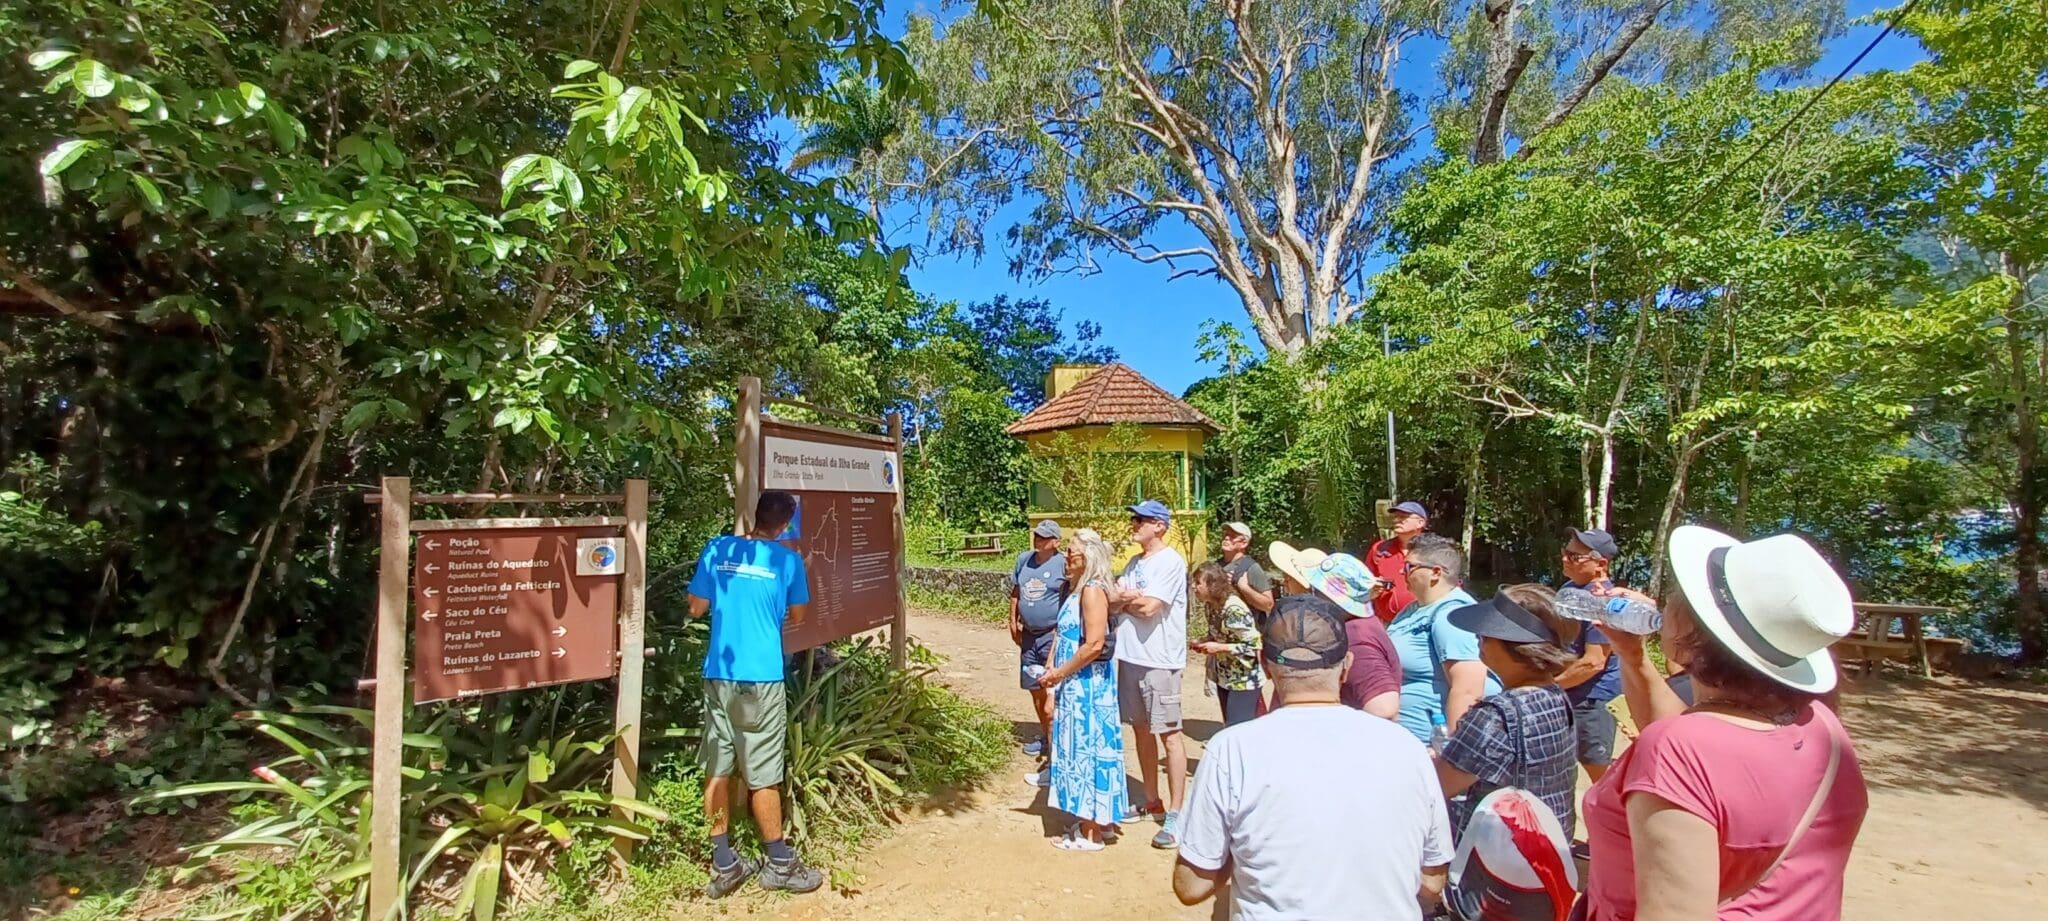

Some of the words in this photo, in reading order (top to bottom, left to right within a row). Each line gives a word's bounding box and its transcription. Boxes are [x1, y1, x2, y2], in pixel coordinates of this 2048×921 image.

[773, 452, 798, 467] Parque
[800, 454, 828, 468] Estadual
[830, 458, 837, 468] da
[839, 458, 850, 469] Ilha
[852, 459, 870, 470] Grande
[449, 538, 480, 548] Poção
[448, 561, 484, 570] Ruínas
[486, 560, 499, 569] do
[502, 559, 549, 569] Aqueduto
[447, 584, 497, 593] Cachoeira
[500, 582, 512, 591] da
[515, 581, 561, 590] Feiticeira
[479, 593, 508, 602] Waterfall
[446, 608, 470, 618] Saco
[473, 607, 486, 616] do
[489, 606, 508, 615] Céu
[445, 619, 457, 627] Céu
[445, 632, 471, 642] Praia
[475, 630, 501, 639] Preta
[444, 655, 480, 665] Ruínas
[482, 653, 495, 662] do
[498, 650, 541, 660] Lazareto
